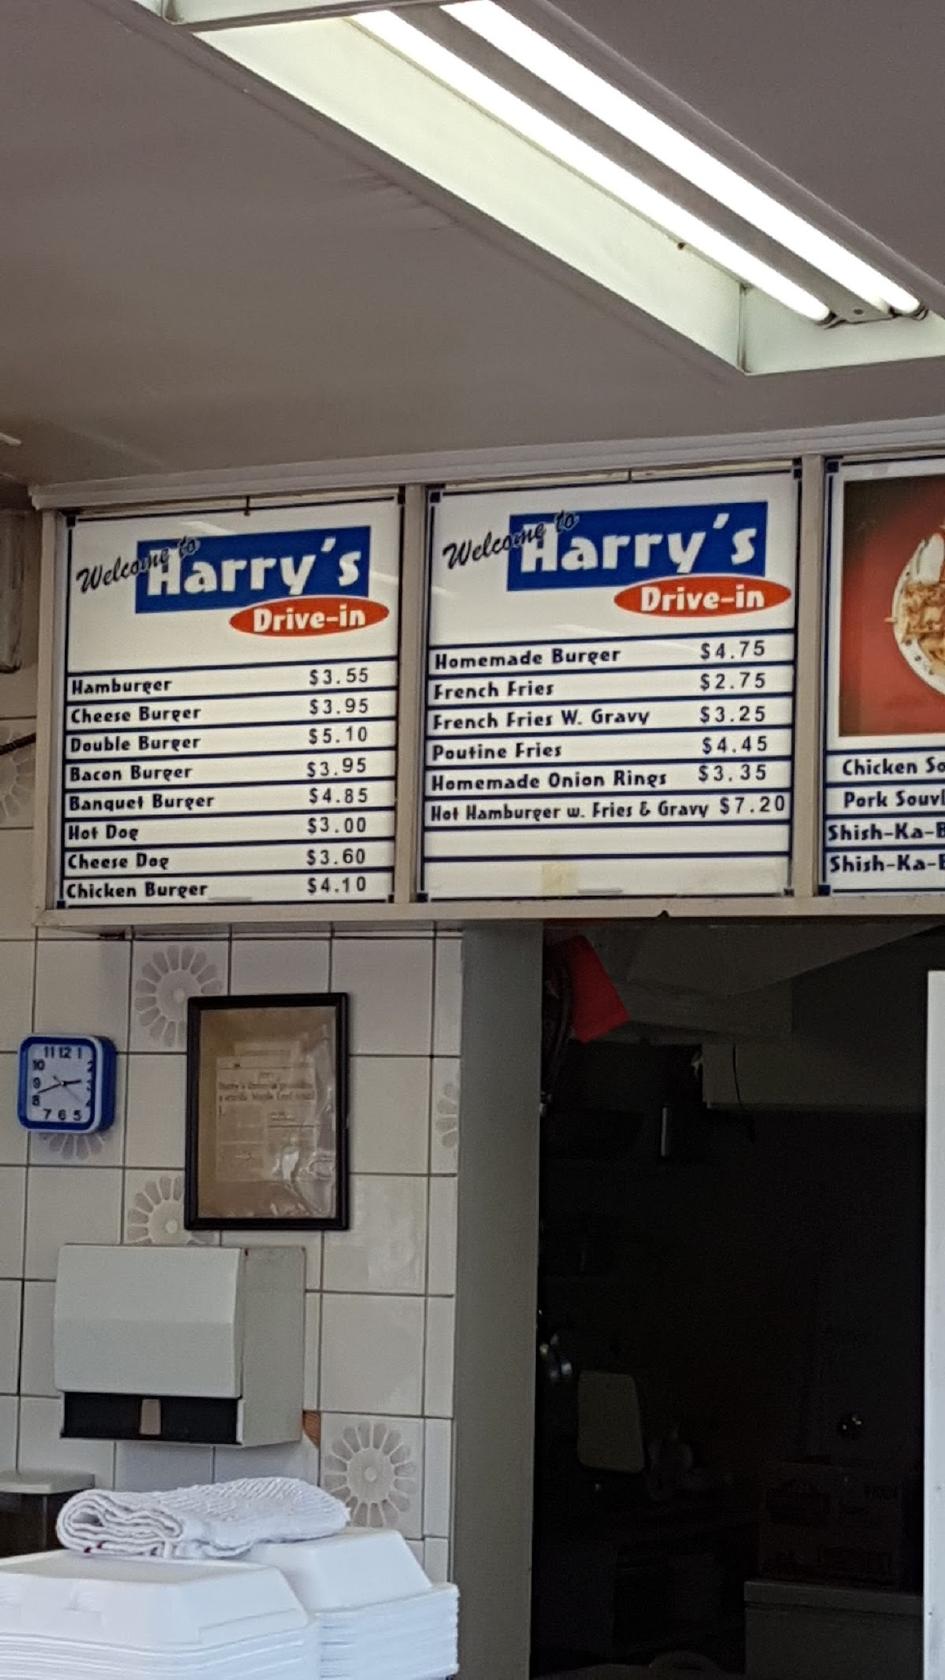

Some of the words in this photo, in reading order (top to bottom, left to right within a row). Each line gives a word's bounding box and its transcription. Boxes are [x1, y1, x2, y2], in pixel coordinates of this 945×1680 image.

[443, 521, 546, 570] Welcome
[553, 510, 580, 532] to
[520, 513, 757, 574] Harry's
[76, 547, 170, 595] Welcome
[177, 536, 200, 559] to
[147, 536, 362, 597] Harry's
[640, 584, 766, 612] Drive-in
[253, 603, 366, 633] Drive-in
[434, 651, 543, 670] Homemade
[551, 648, 622, 667] Burger
[700, 640, 766, 660] $4.75
[71, 677, 173, 695] Hamburger
[308, 667, 369, 687] $3.55
[433, 682, 499, 700] French
[507, 680, 554, 697] Fries
[700, 672, 766, 691] $2.75
[71, 708, 131, 724] Cheese
[138, 706, 202, 723] Burger
[309, 698, 369, 715] $3.95
[432, 713, 498, 730] French
[506, 710, 553, 728] Fries
[560, 710, 582, 726] W.
[591, 708, 650, 726] Gravy
[699, 705, 766, 724] $3.25
[71, 736, 131, 752] Double
[138, 735, 201, 752] Burger
[308, 726, 368, 745] $5.10
[432, 743, 508, 761] Poutine
[515, 742, 562, 758] Fries
[702, 735, 768, 755] $4.45
[69, 766, 123, 782] Bacon
[130, 765, 193, 782] Burger
[306, 757, 367, 777] $3.95
[431, 774, 540, 792] Homemade
[548, 773, 605, 788] Onion
[613, 770, 667, 788] Rings
[698, 764, 767, 783] $3.35
[842, 758, 917, 775] Chicken
[69, 795, 144, 812] Banquet
[152, 793, 215, 811] Burger
[308, 788, 368, 804] $4.85
[430, 805, 459, 822] Hot
[466, 802, 561, 822] Hamburger
[567, 805, 585, 818] w.
[592, 802, 632, 817] Fries
[639, 801, 650, 816] &
[658, 800, 709, 819] Gravy
[719, 795, 785, 815] $7.20
[844, 791, 888, 808] Pork
[67, 825, 99, 841] Hot
[105, 824, 139, 841] Dog
[307, 817, 367, 834] $3.00
[67, 854, 128, 870] Cheese
[135, 852, 169, 870] Dog
[306, 849, 366, 866] $3.60
[66, 884, 137, 899] Chicken
[144, 882, 208, 899] Burger
[307, 876, 367, 894] $4.10
[32, 1059, 45, 1071] 10
[44, 1046, 55, 1058] 11
[59, 1047, 71, 1058] 12
[78, 1047, 82, 1059] 1
[33, 1077, 41, 1088] 9
[32, 1095, 40, 1106] 8
[43, 1109, 51, 1119] 7
[58, 1109, 66, 1120] 6
[73, 1110, 81, 1121] 5
